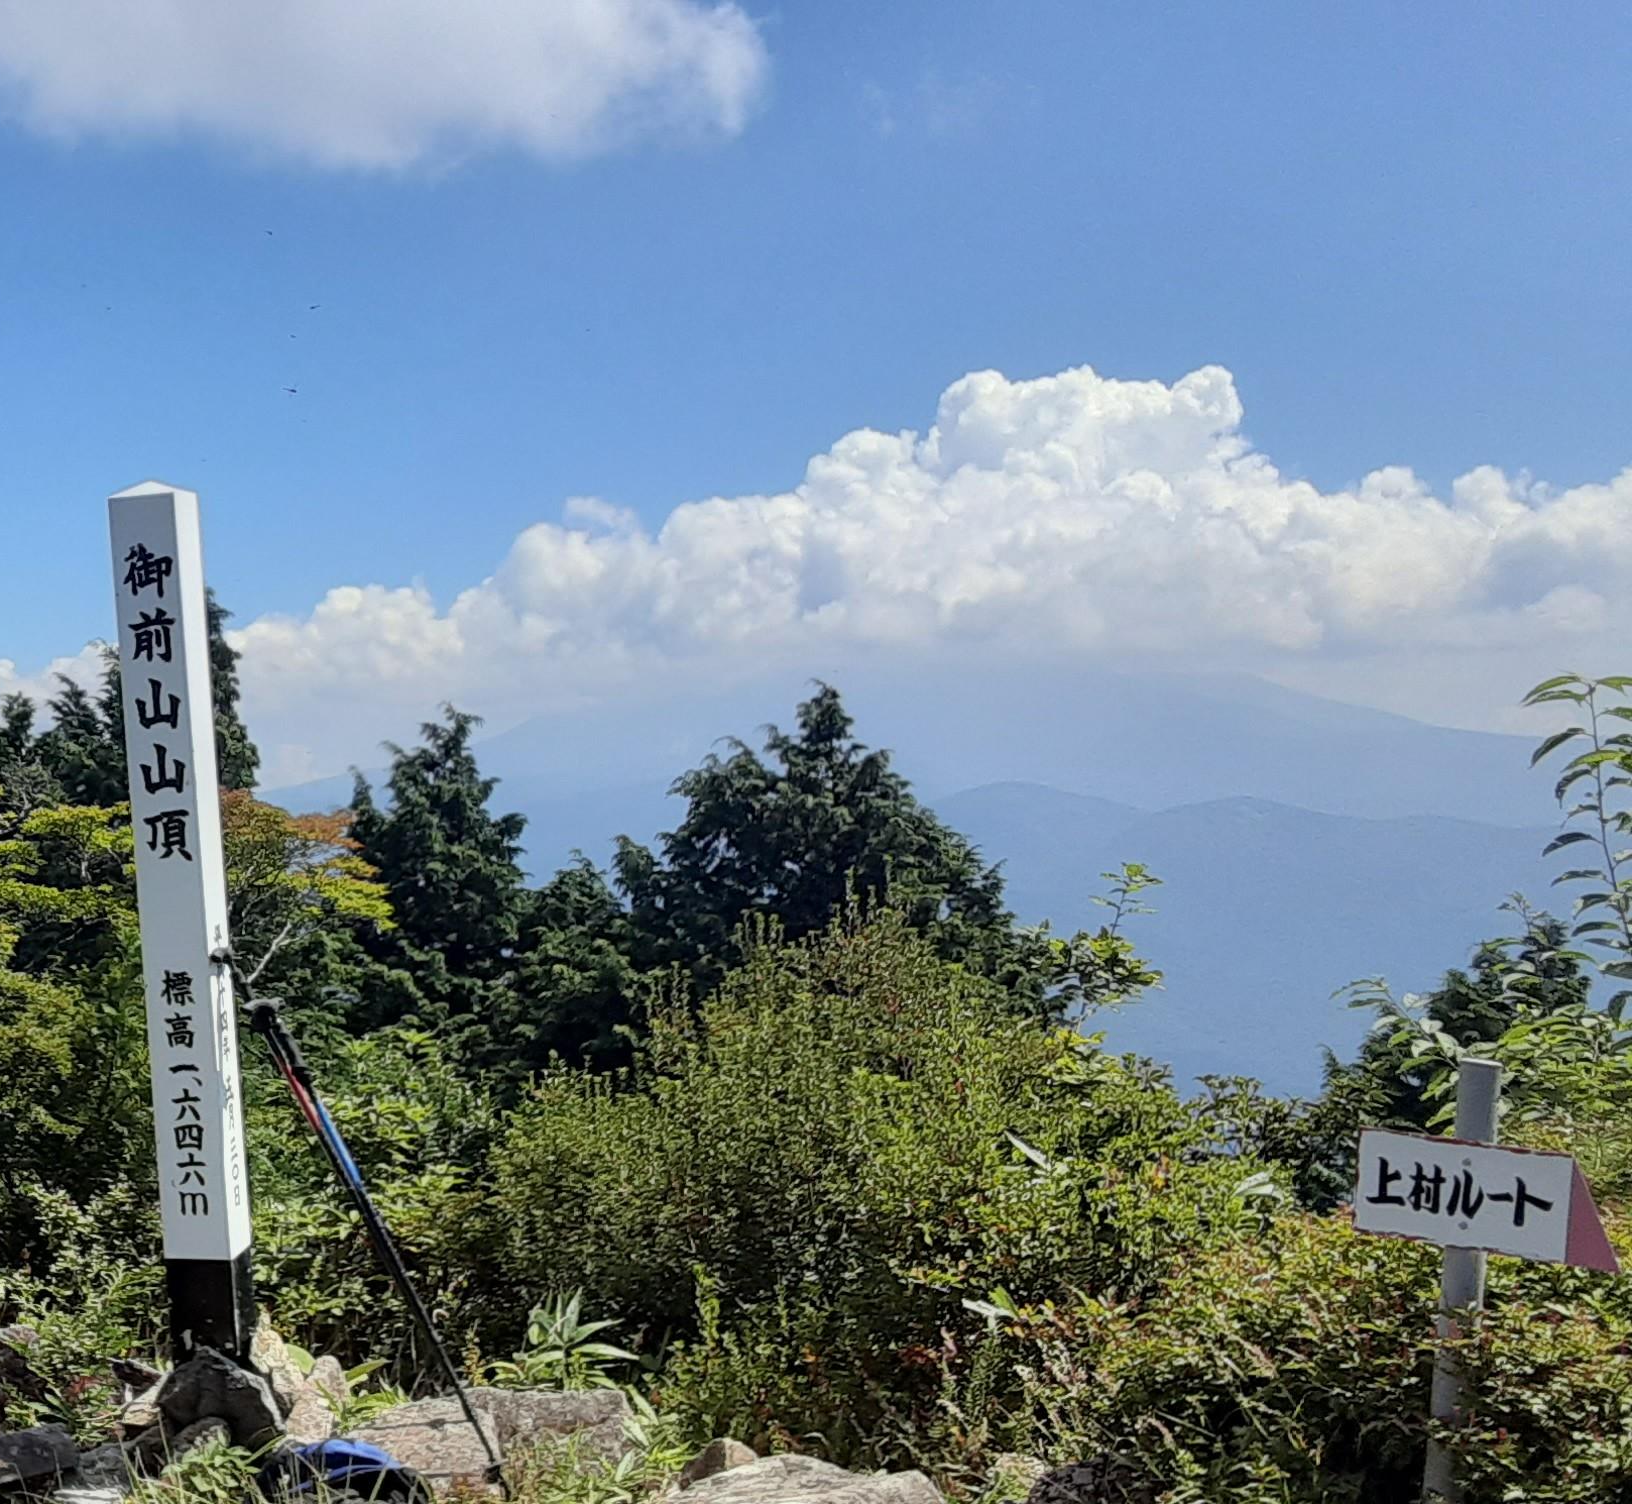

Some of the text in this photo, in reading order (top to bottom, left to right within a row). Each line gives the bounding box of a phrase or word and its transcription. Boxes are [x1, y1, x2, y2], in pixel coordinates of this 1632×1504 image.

[123, 543, 193, 862] 御前山山頂
[1366, 1156, 1554, 1227] 上村ルート
